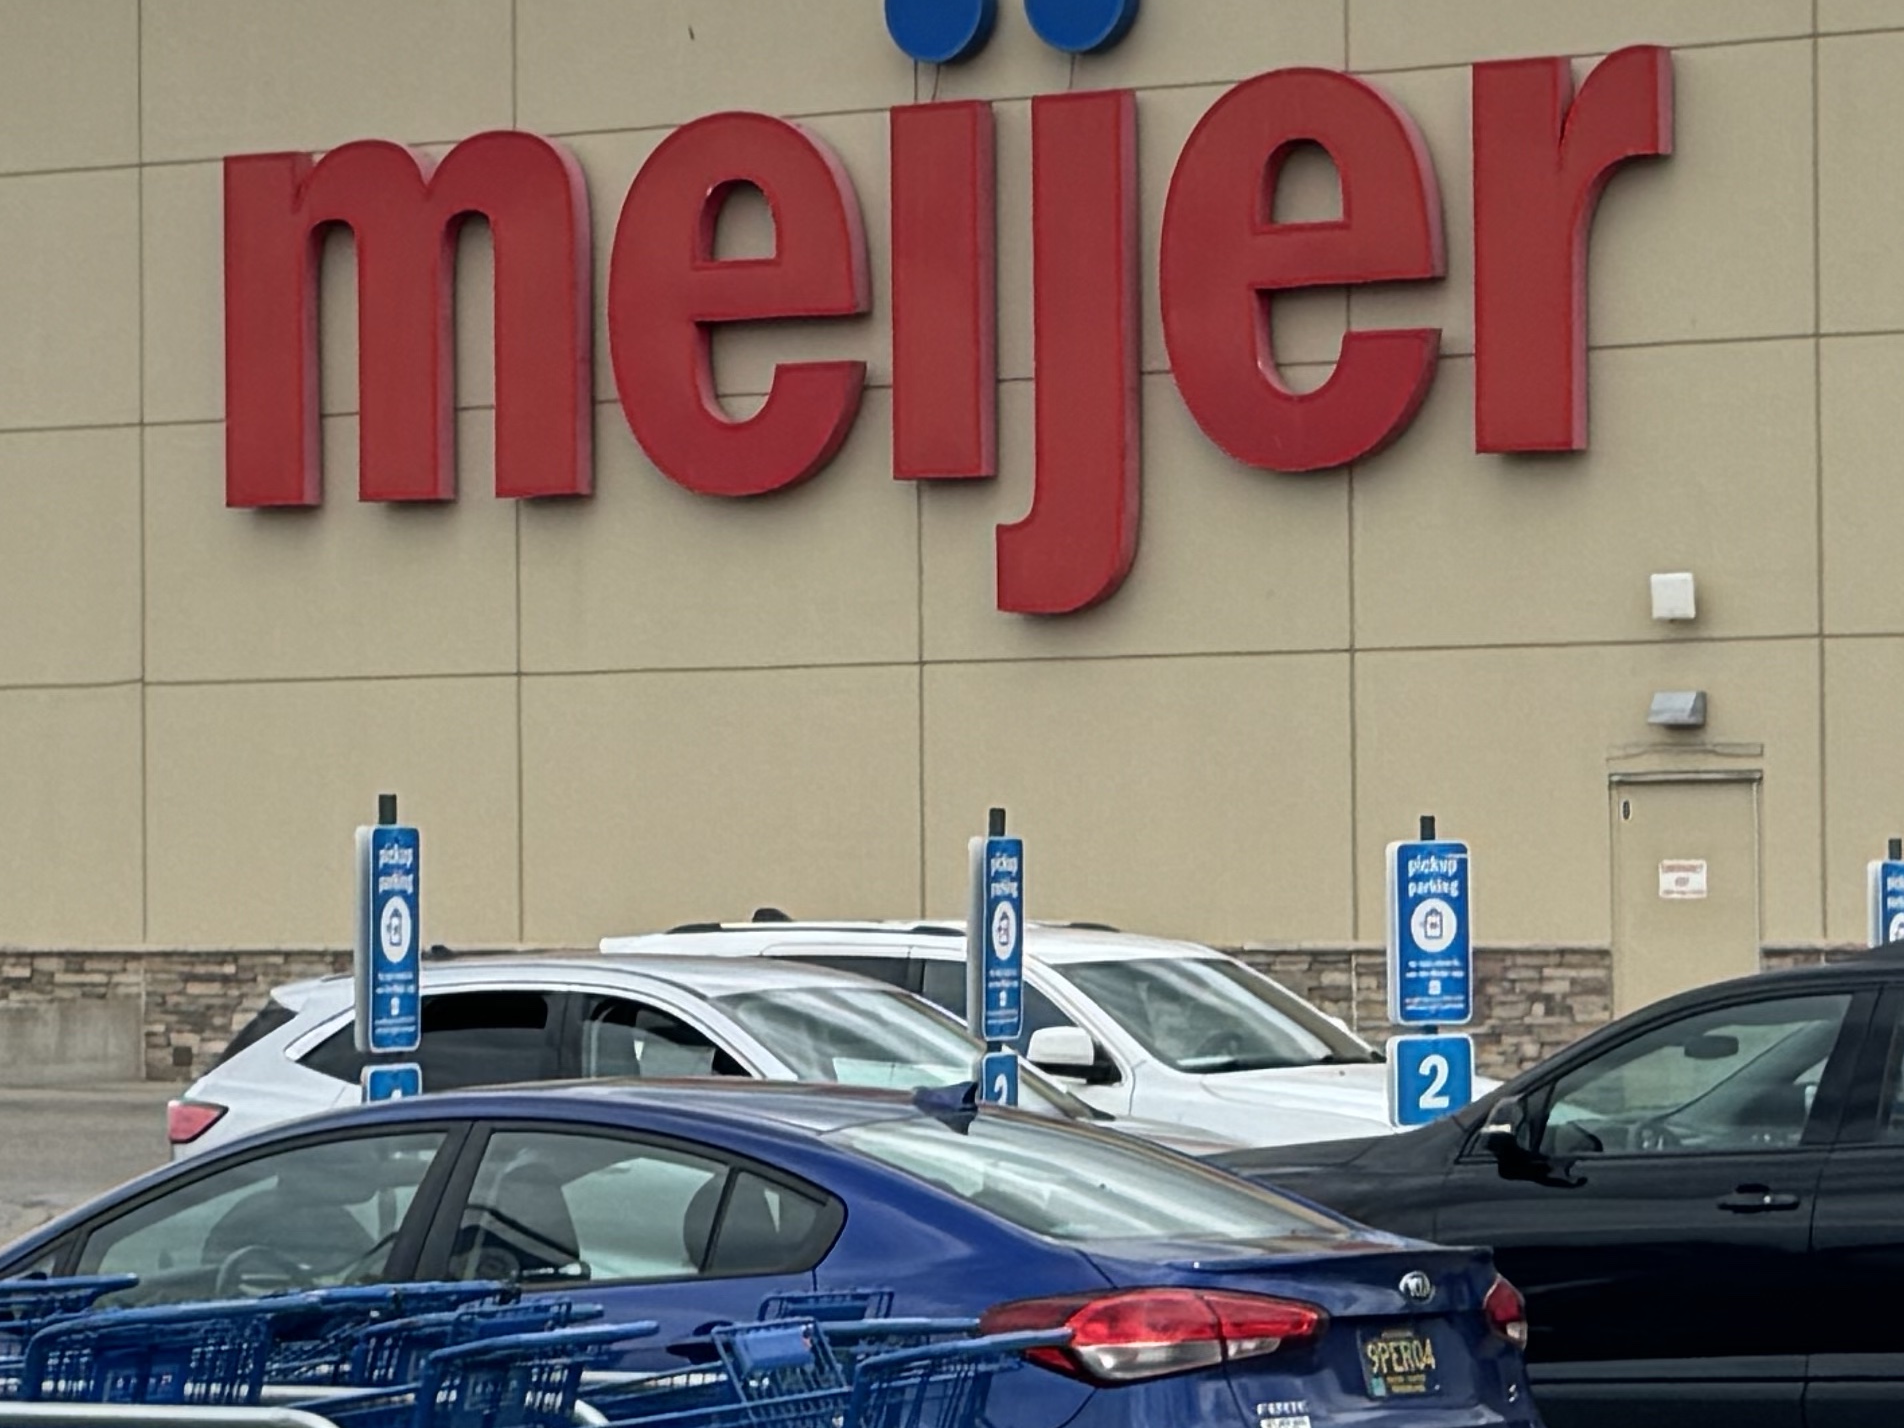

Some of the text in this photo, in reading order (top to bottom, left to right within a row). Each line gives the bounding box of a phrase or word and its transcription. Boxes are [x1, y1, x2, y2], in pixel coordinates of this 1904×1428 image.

[1408, 854, 1457, 878] pickup
[1408, 879, 1459, 898] parking
[1418, 1054, 1450, 1109] 2
